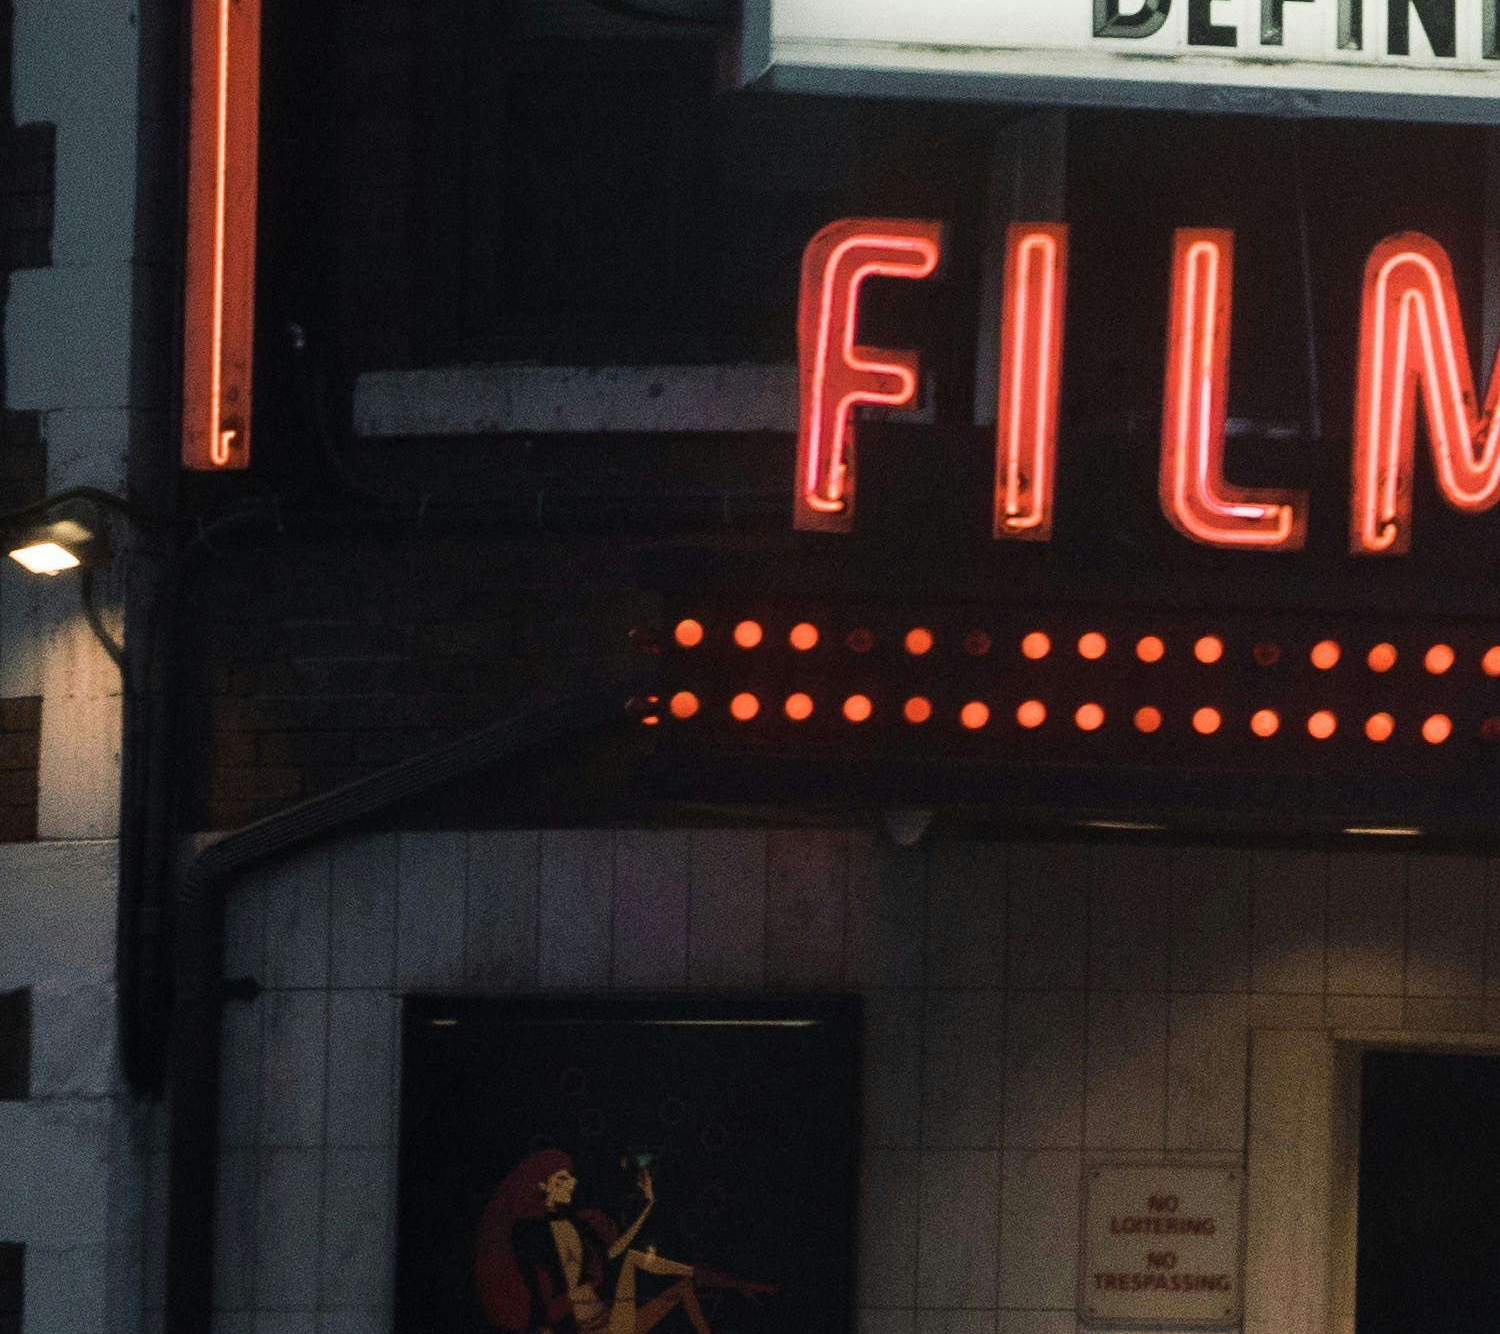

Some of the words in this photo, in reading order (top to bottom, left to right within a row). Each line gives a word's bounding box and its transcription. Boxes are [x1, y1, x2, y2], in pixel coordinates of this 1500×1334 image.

[1148, 1194, 1180, 1213] NO
[1109, 1216, 1217, 1237] LOITERING
[1147, 1251, 1178, 1270] NO
[1093, 1272, 1232, 1293] TRESPASSING
